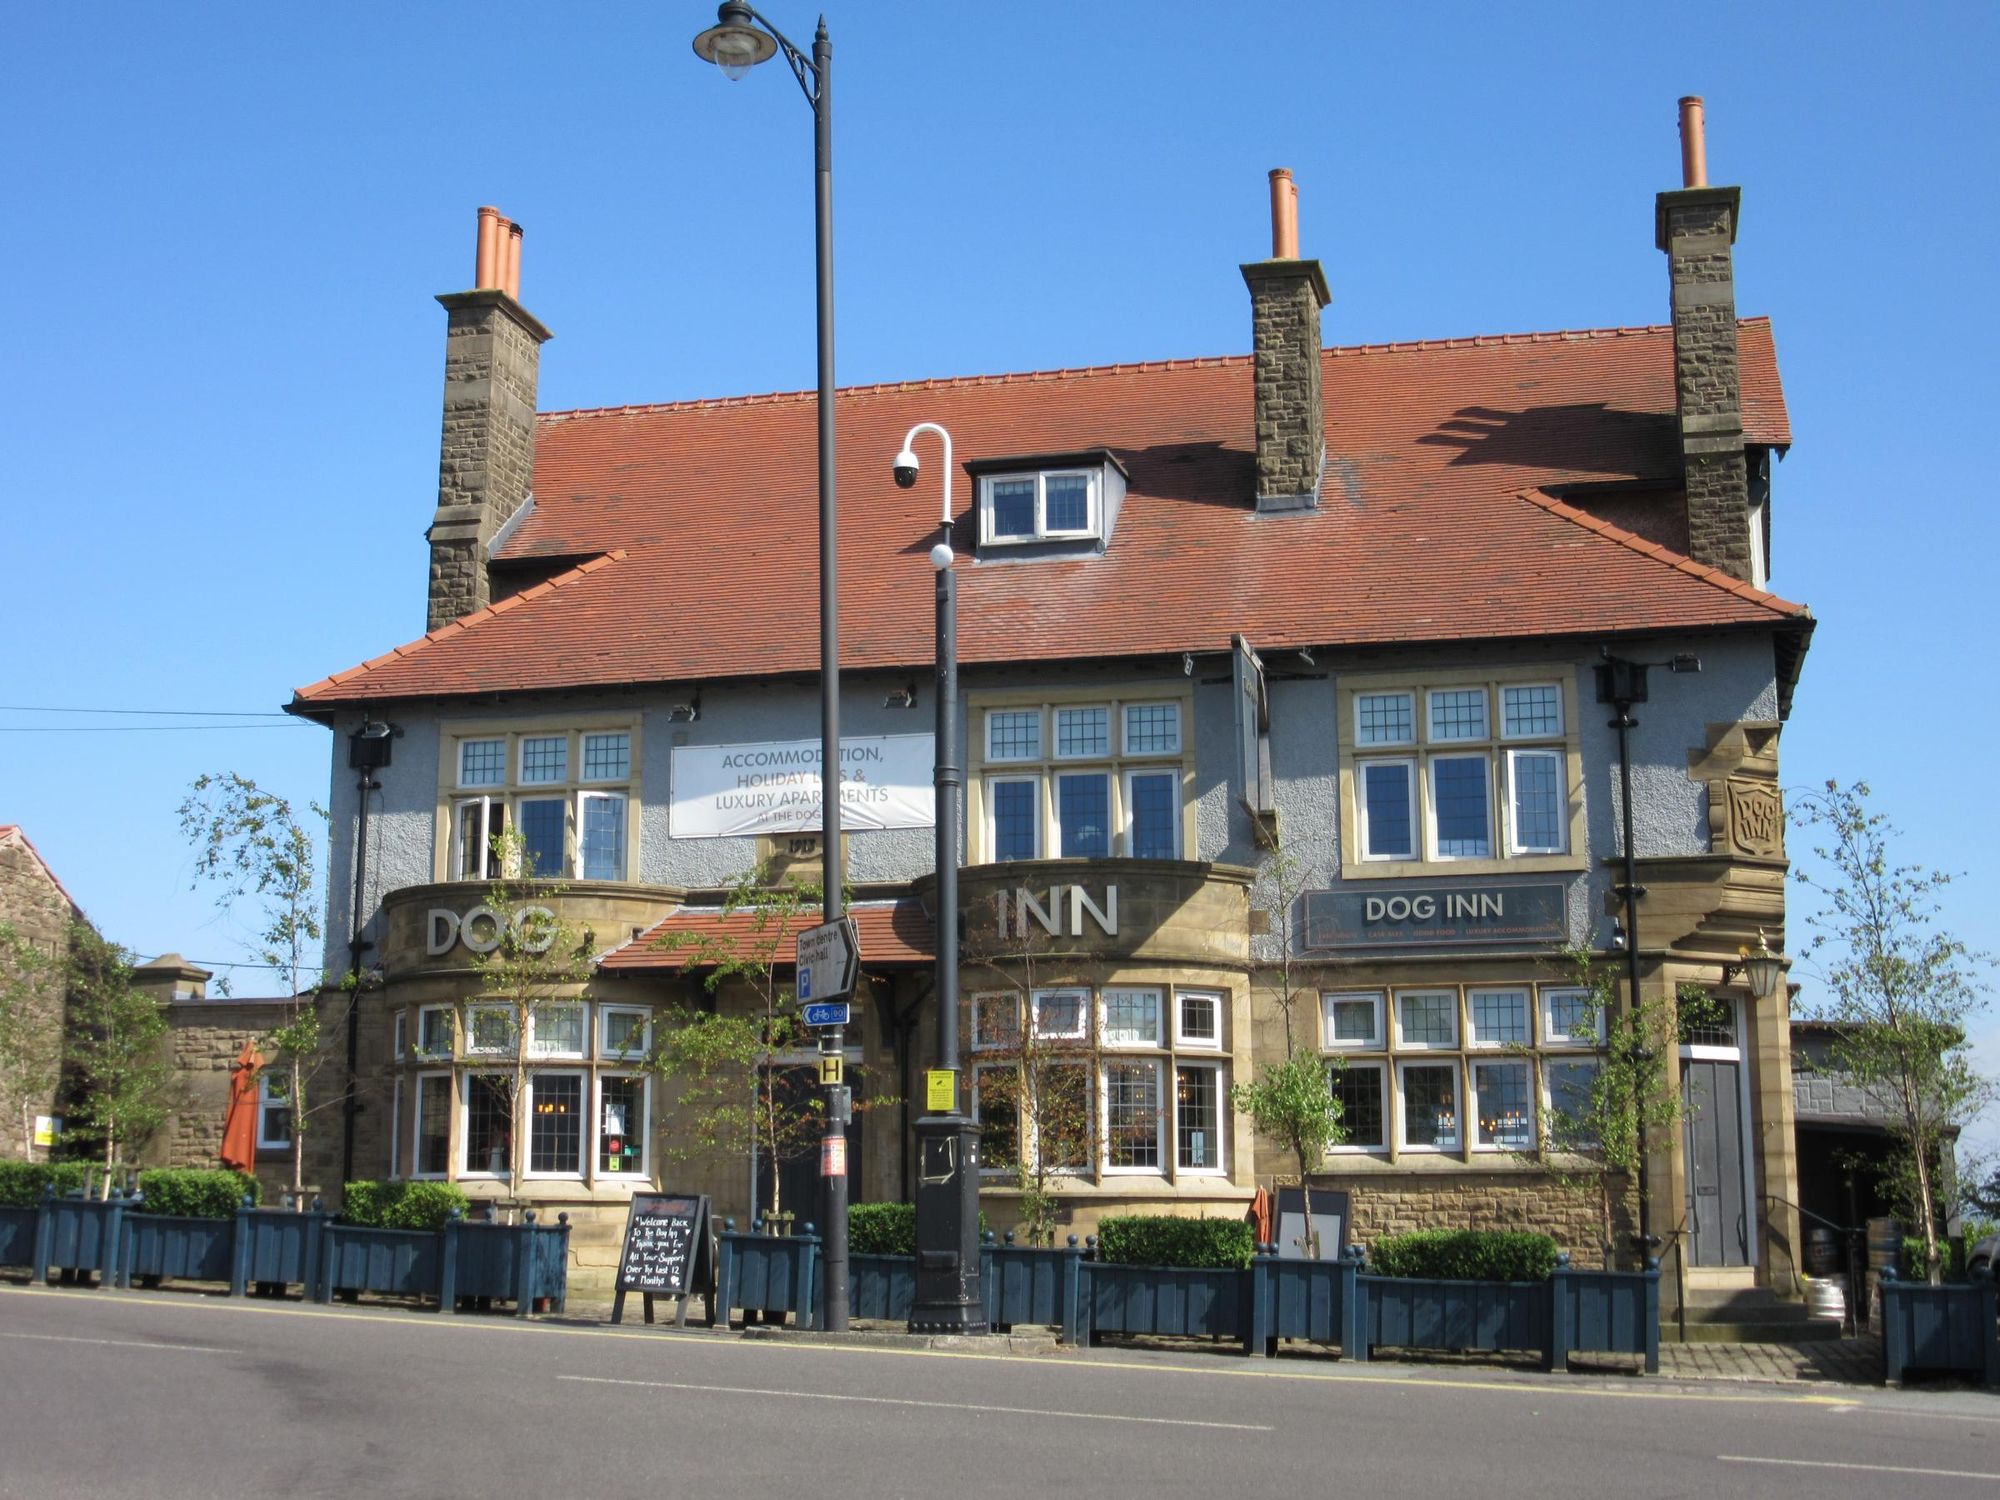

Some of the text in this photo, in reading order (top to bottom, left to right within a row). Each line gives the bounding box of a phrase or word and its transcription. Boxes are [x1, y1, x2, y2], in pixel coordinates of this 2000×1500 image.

[722, 747, 884, 769] ACCOMMODTION,
[737, 768, 866, 788] HOLIDAY LS &
[716, 788, 889, 810] LUXURY APARENTS
[1736, 797, 1774, 821] DOG
[773, 811, 793, 822] THE
[796, 809, 821, 821] DOG
[1740, 817, 1772, 841] INN
[998, 884, 1118, 938] INN
[1366, 893, 1504, 921] DOG INN
[426, 904, 558, 956] DOG
[799, 930, 838, 951] Town centre
[1465, 927, 1492, 936] LUXURY
[639, 1216, 669, 1227] Welcome
[643, 1252, 658, 1261] Your
[658, 1252, 686, 1265] Support
[625, 1265, 643, 1273] Over
[655, 1265, 669, 1274] Last
[672, 1266, 680, 1274] 12
[640, 1275, 665, 1286] Months
